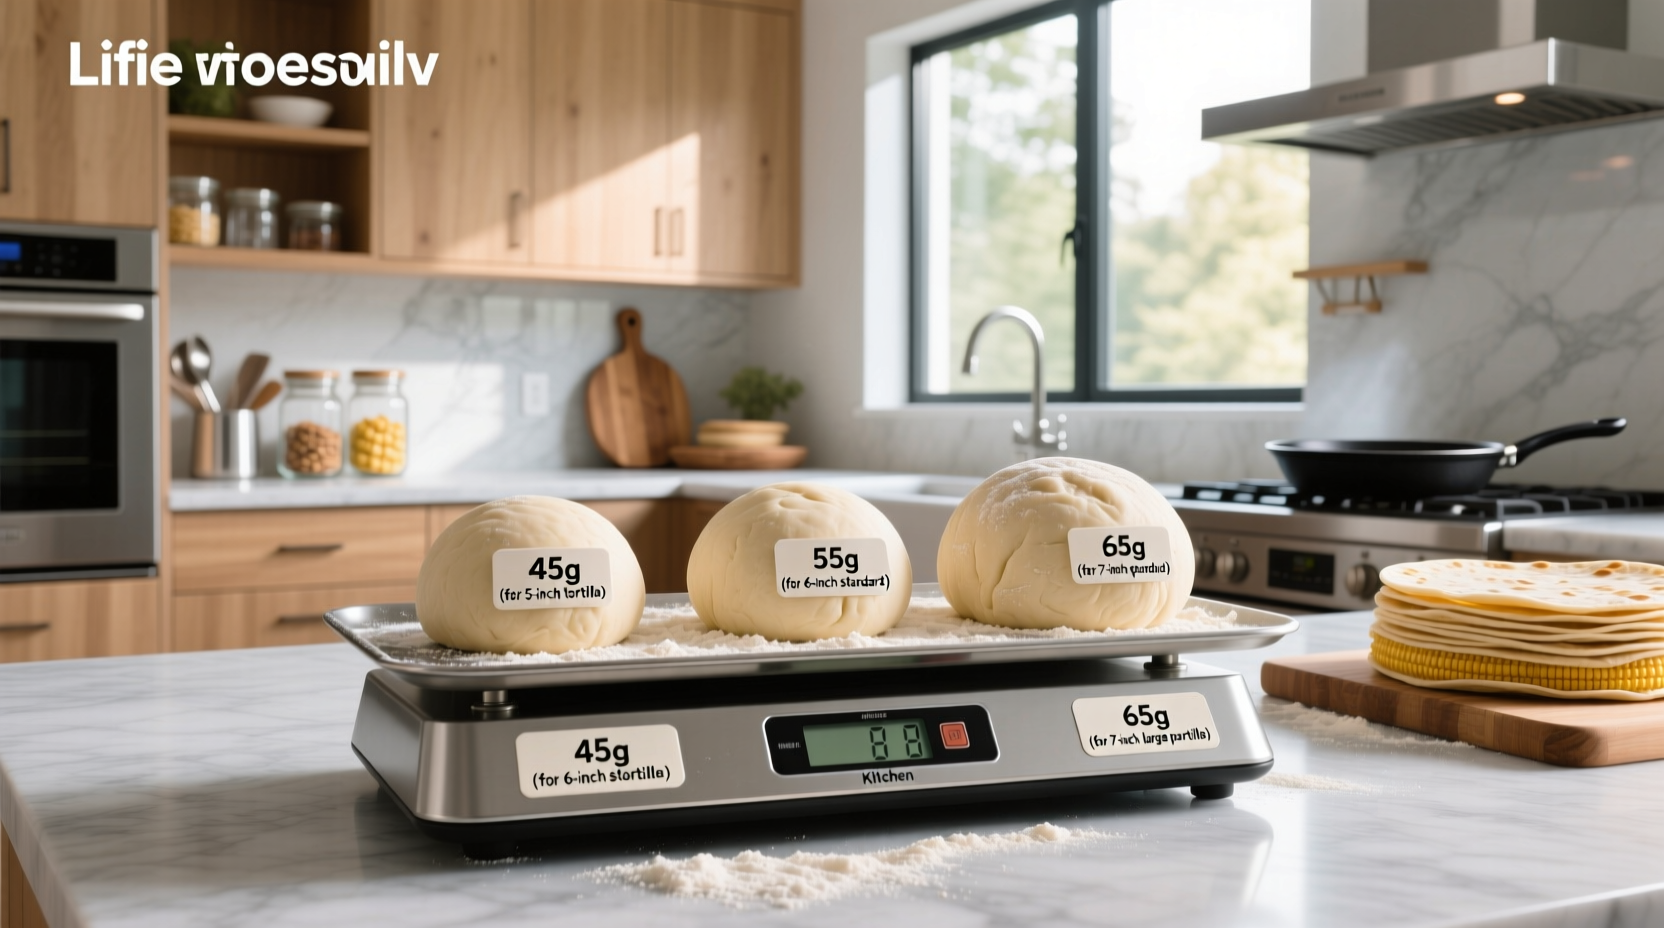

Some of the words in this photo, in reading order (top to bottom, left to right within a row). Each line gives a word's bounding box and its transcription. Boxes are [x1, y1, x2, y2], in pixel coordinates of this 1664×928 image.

[813, 546, 859, 574] 55g
[1102, 534, 1146, 561] 65g
[528, 556, 581, 586] 45g
[524, 587, 561, 601] 5-inch
[781, 576, 801, 593] (for
[1122, 704, 1170, 730] 65g
[574, 737, 630, 768] 45g
[532, 772, 560, 790] (for
[563, 769, 607, 786] 6-inch
